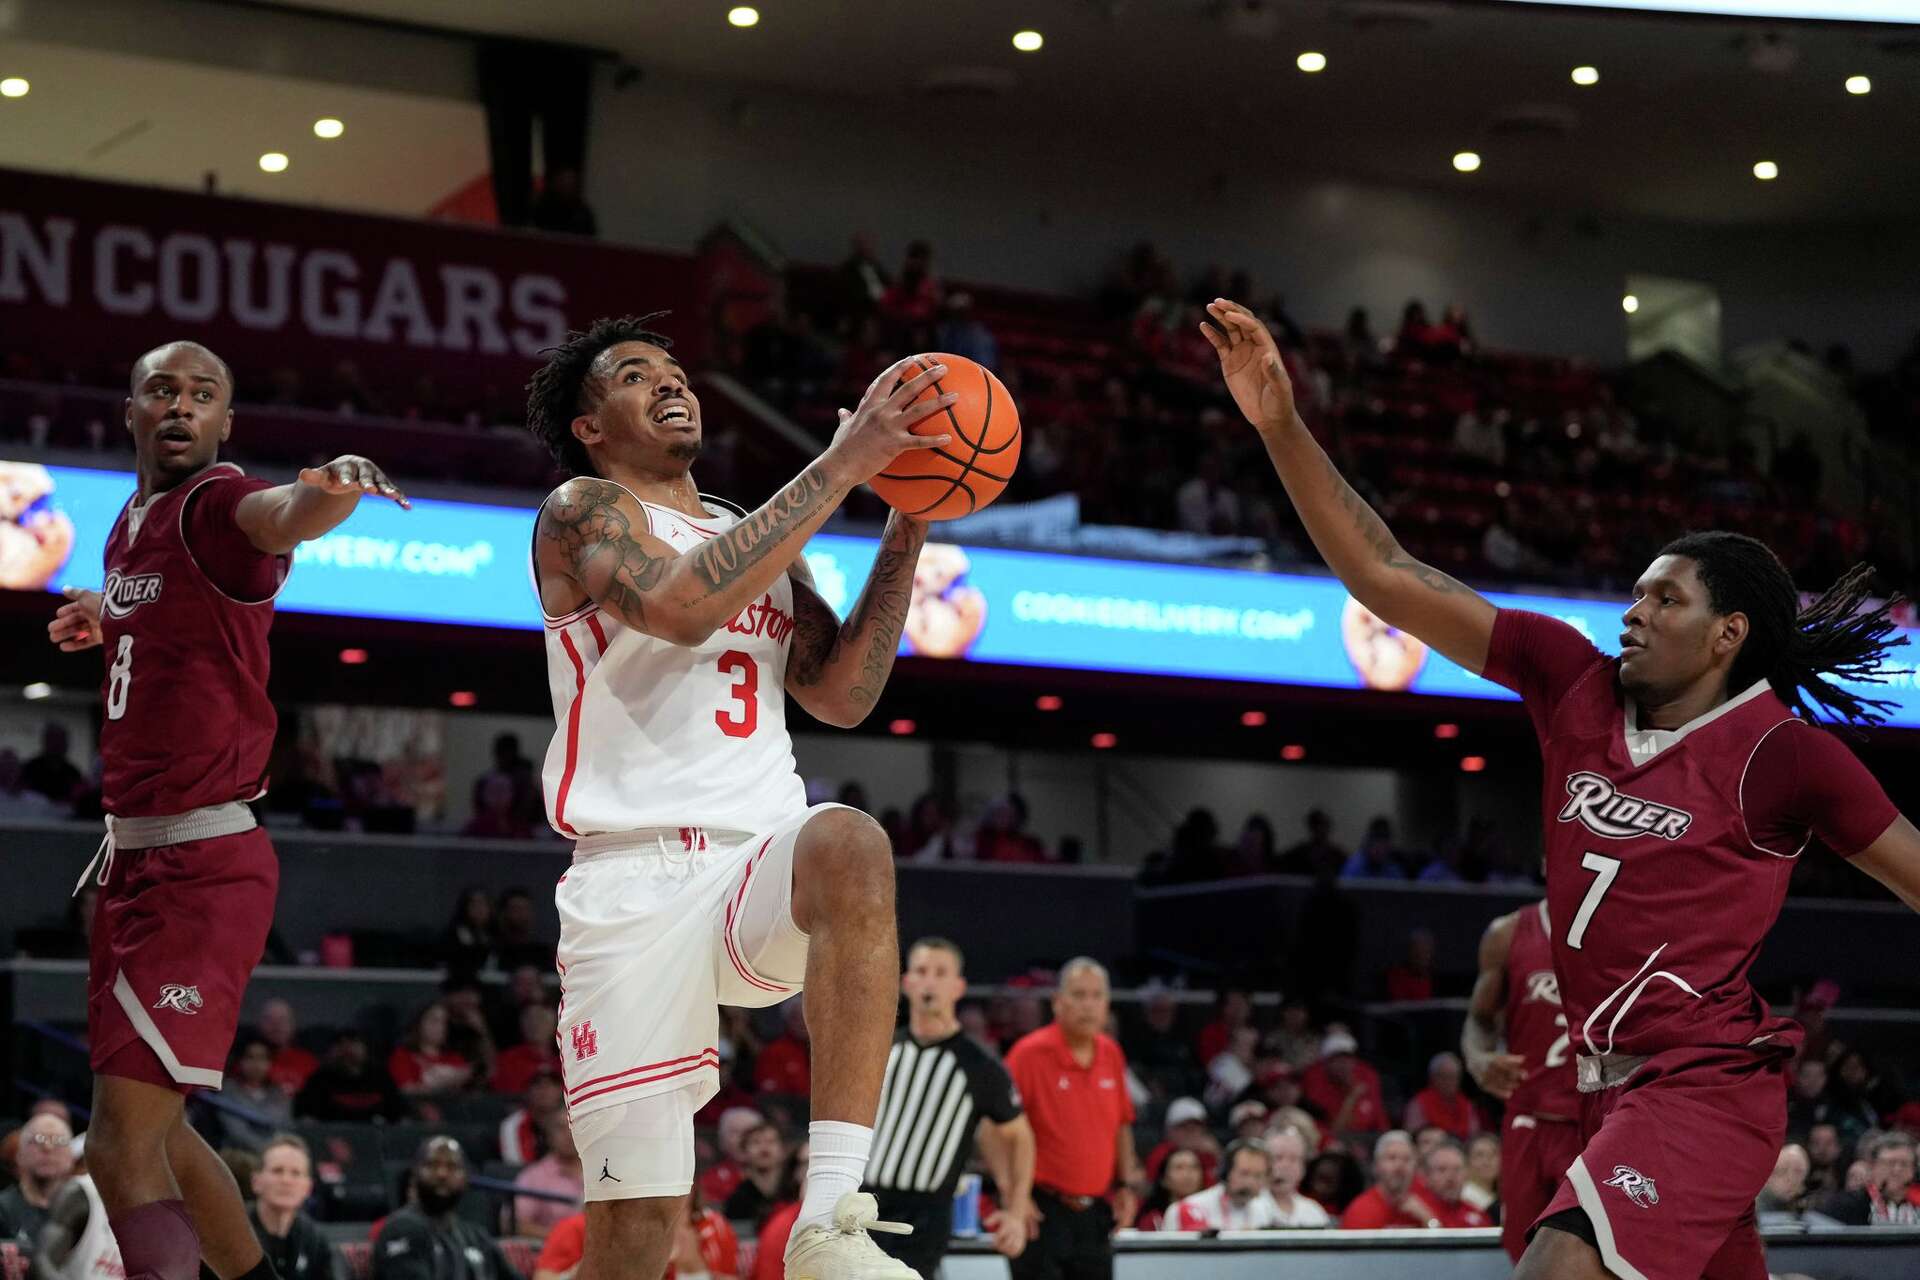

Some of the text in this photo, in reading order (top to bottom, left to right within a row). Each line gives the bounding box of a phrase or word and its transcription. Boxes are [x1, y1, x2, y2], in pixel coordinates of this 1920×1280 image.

[94, 225, 570, 358] COUGARS
[100, 568, 163, 619] RIDER
[107, 634, 134, 721] 8
[714, 649, 760, 739] 3
[1557, 770, 1693, 841] RIDER
[1566, 851, 1622, 950] 7
